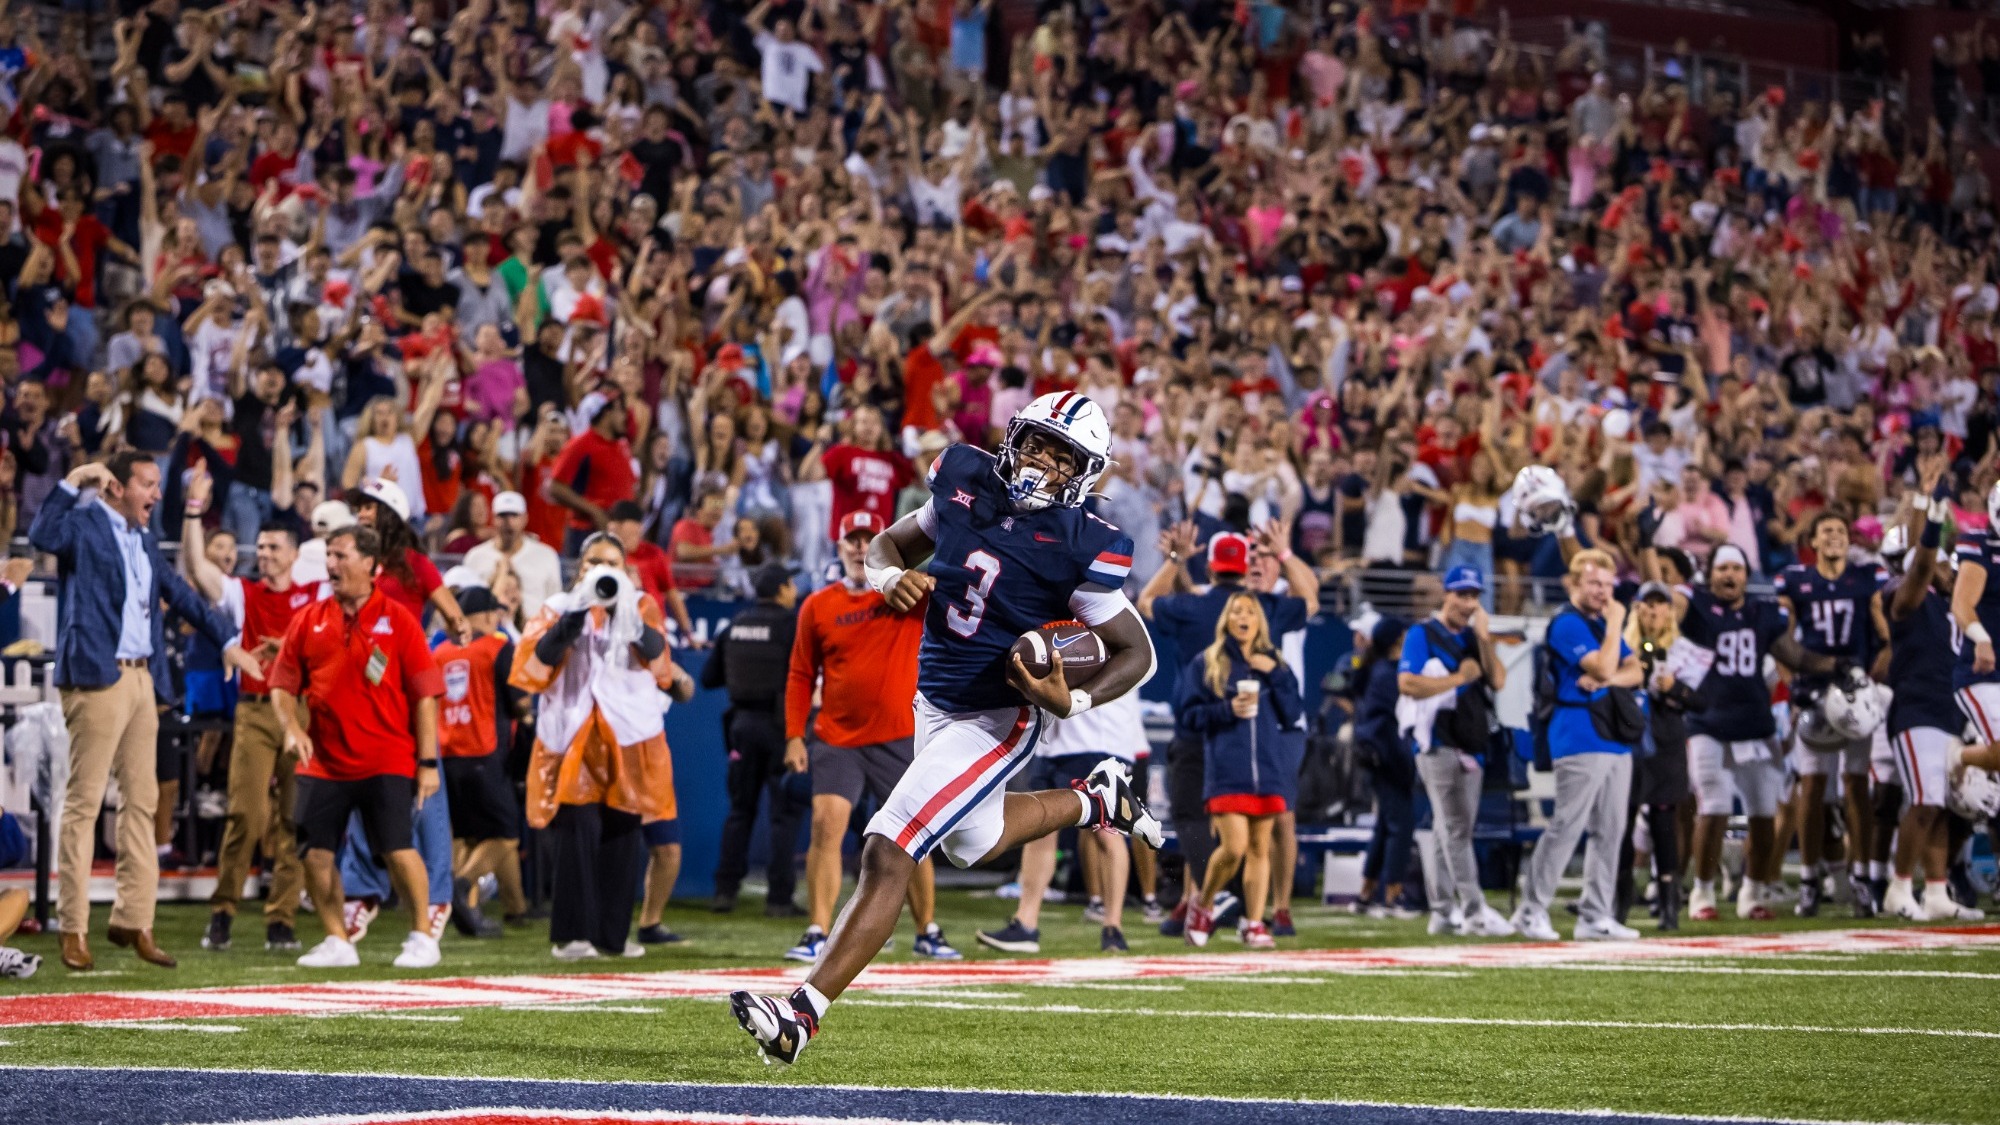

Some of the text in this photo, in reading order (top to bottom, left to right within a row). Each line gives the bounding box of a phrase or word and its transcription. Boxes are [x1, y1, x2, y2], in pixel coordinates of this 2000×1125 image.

[1042, 417, 1070, 432] ARIZONA
[944, 549, 1001, 639] 3
[730, 625, 770, 641] POLICE
[1811, 599, 1854, 647] 47
[1716, 628, 1757, 677] 98
